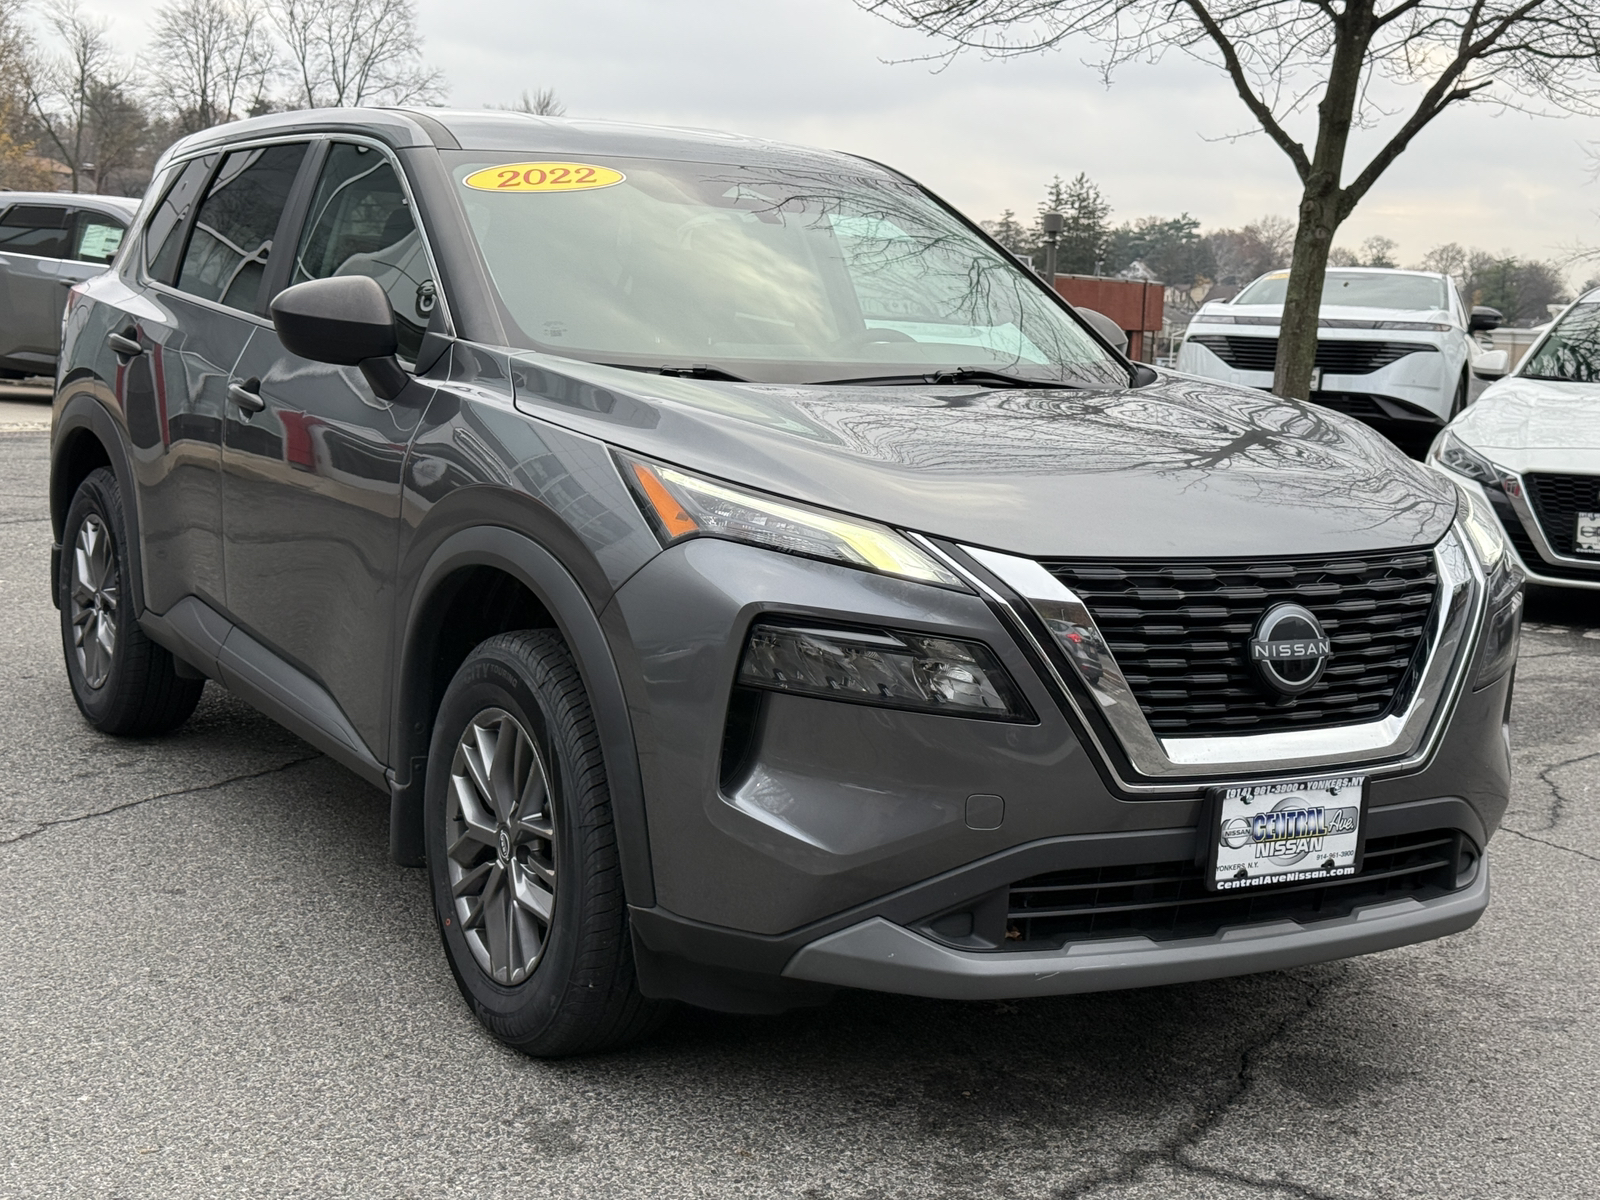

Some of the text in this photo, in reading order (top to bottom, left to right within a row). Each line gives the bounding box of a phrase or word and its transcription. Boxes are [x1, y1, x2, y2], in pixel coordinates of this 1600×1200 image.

[497, 167, 597, 188] 2022
[1254, 641, 1329, 657] NISSAN
[1224, 828, 1251, 837] NISSAN
[1253, 806, 1354, 843] CENTRAL Ave.
[1255, 836, 1324, 859] NISSAN
[1316, 850, 1354, 860] 914-961-3900
[1248, 861, 1259, 869] N.Y.
